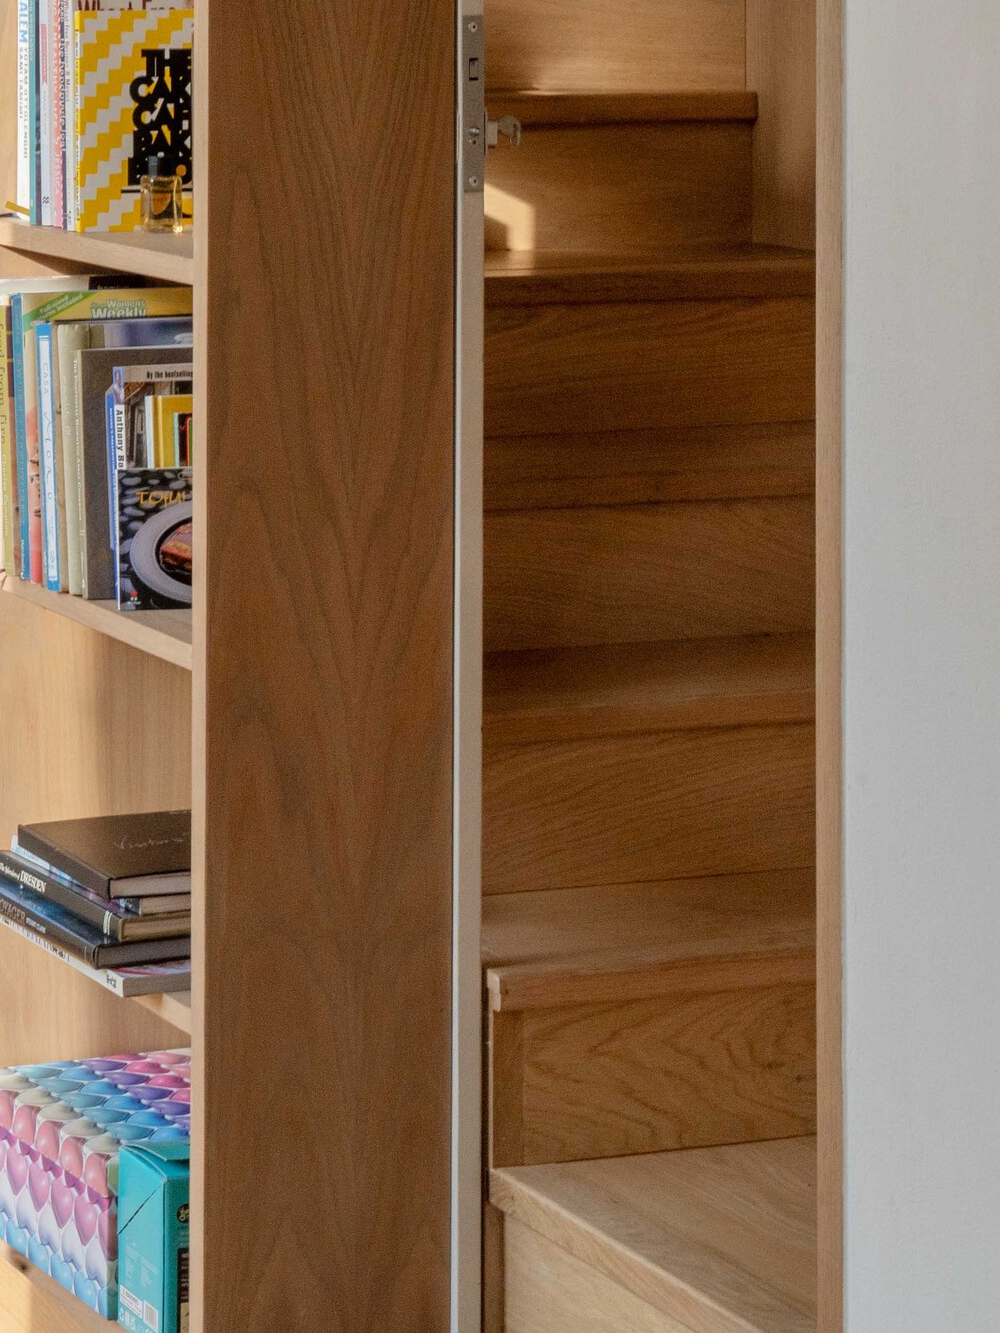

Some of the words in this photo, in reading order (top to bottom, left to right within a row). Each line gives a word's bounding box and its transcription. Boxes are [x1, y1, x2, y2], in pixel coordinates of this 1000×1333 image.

[129, 76, 192, 106] CAK
[91, 307, 147, 319] Weekly
[147, 371, 153, 380] By
[155, 370, 163, 379] the
[116, 409, 124, 452] Anthony
[20, 869, 47, 894] DRESDEN
